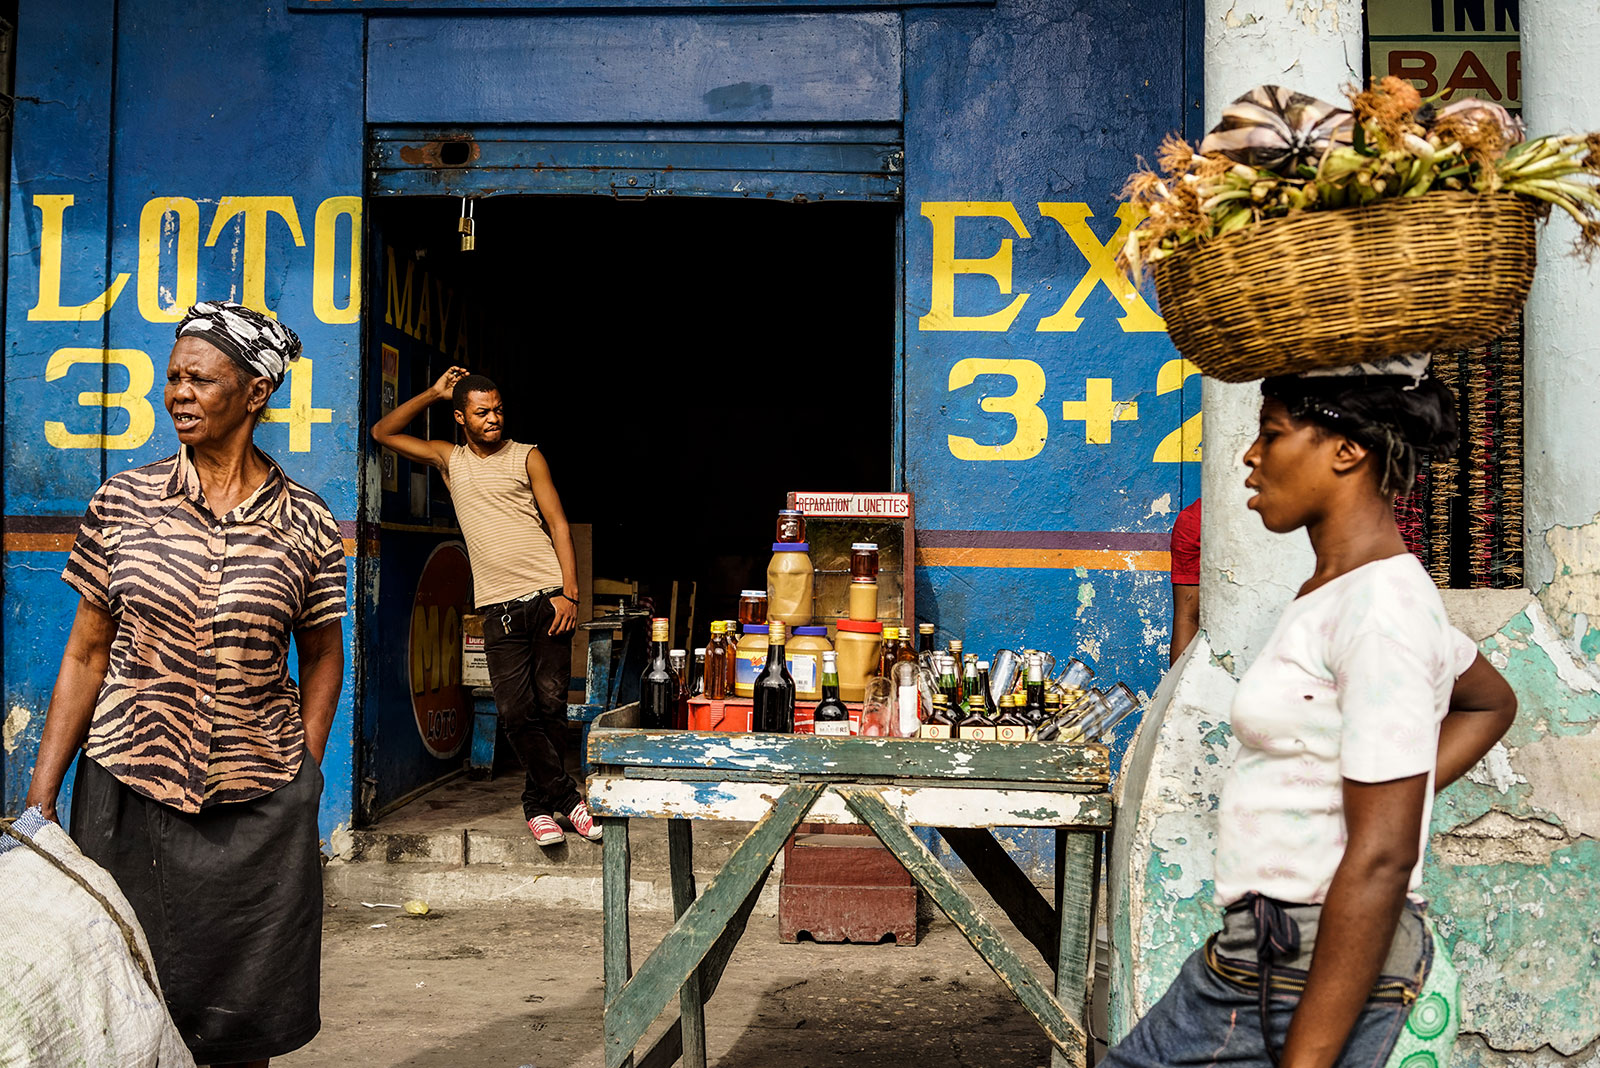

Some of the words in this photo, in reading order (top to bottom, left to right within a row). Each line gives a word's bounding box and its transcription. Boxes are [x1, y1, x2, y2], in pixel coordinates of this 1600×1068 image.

[27, 194, 362, 324] LOTO
[798, 497, 849, 512] REPARATION
[857, 498, 906, 513] LUNETTES
[414, 605, 461, 694] MA
[427, 708, 457, 741] LOTO
